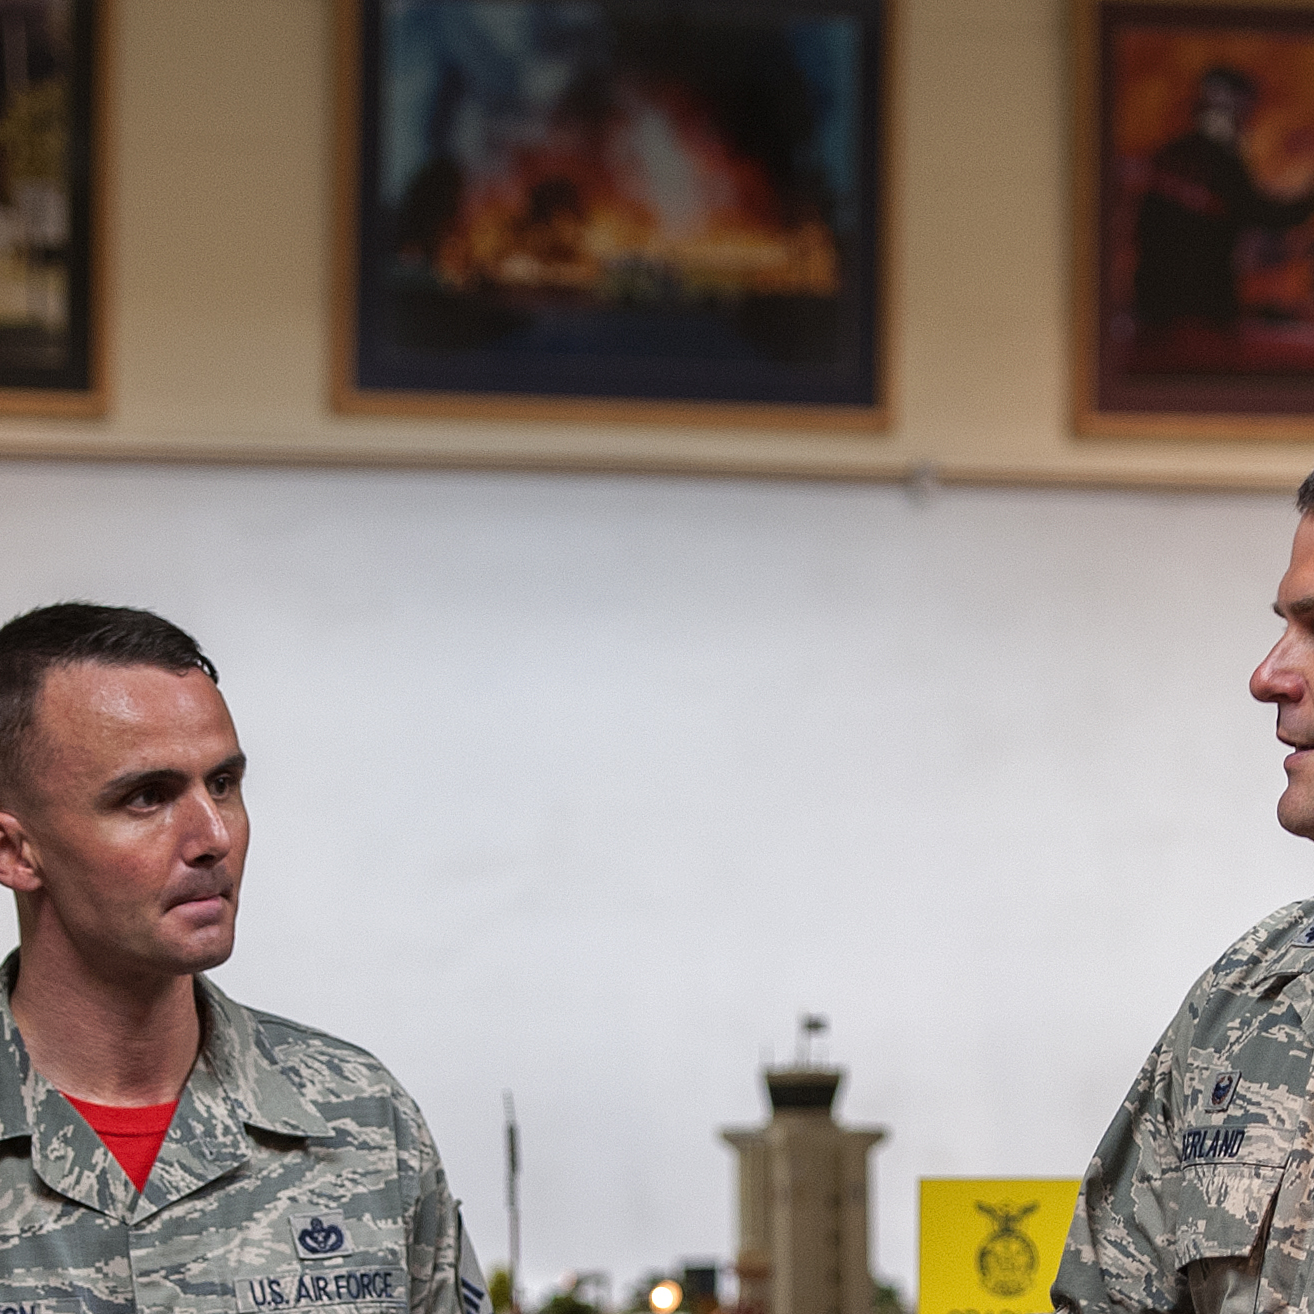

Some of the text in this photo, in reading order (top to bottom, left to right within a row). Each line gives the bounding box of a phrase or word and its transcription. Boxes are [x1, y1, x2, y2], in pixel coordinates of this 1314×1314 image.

[249, 1272, 393, 1307] U.S. AIR FORCE
